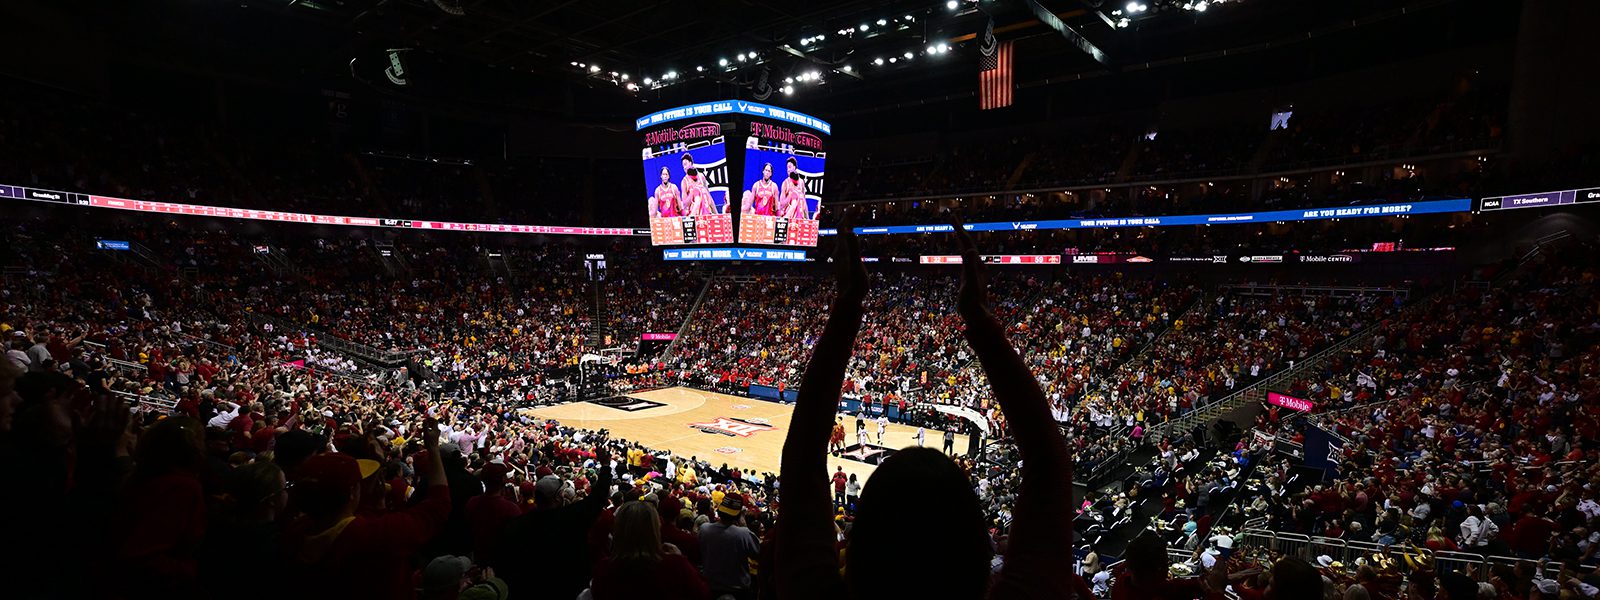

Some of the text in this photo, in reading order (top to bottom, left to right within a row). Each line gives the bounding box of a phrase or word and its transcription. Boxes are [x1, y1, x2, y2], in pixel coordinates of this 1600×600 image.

[664, 108, 686, 120] FUTURE
[686, 107, 694, 115] IS
[694, 104, 712, 114] YOUR
[713, 102, 733, 113] CALL
[769, 108, 786, 118] YOUR
[786, 112, 807, 123] FUTURE
[652, 128, 678, 144] Mobile
[678, 125, 718, 139] CENTER
[763, 124, 796, 142] Mobile
[796, 134, 822, 149] CENTER
[1522, 196, 1549, 205] Southern
[1336, 208, 1363, 216] READY
[1382, 205, 1412, 213] MORE?
[681, 250, 698, 258] READY
[699, 250, 711, 258] FOR
[712, 250, 731, 258] MORE
[1286, 398, 1310, 410] Mobile
